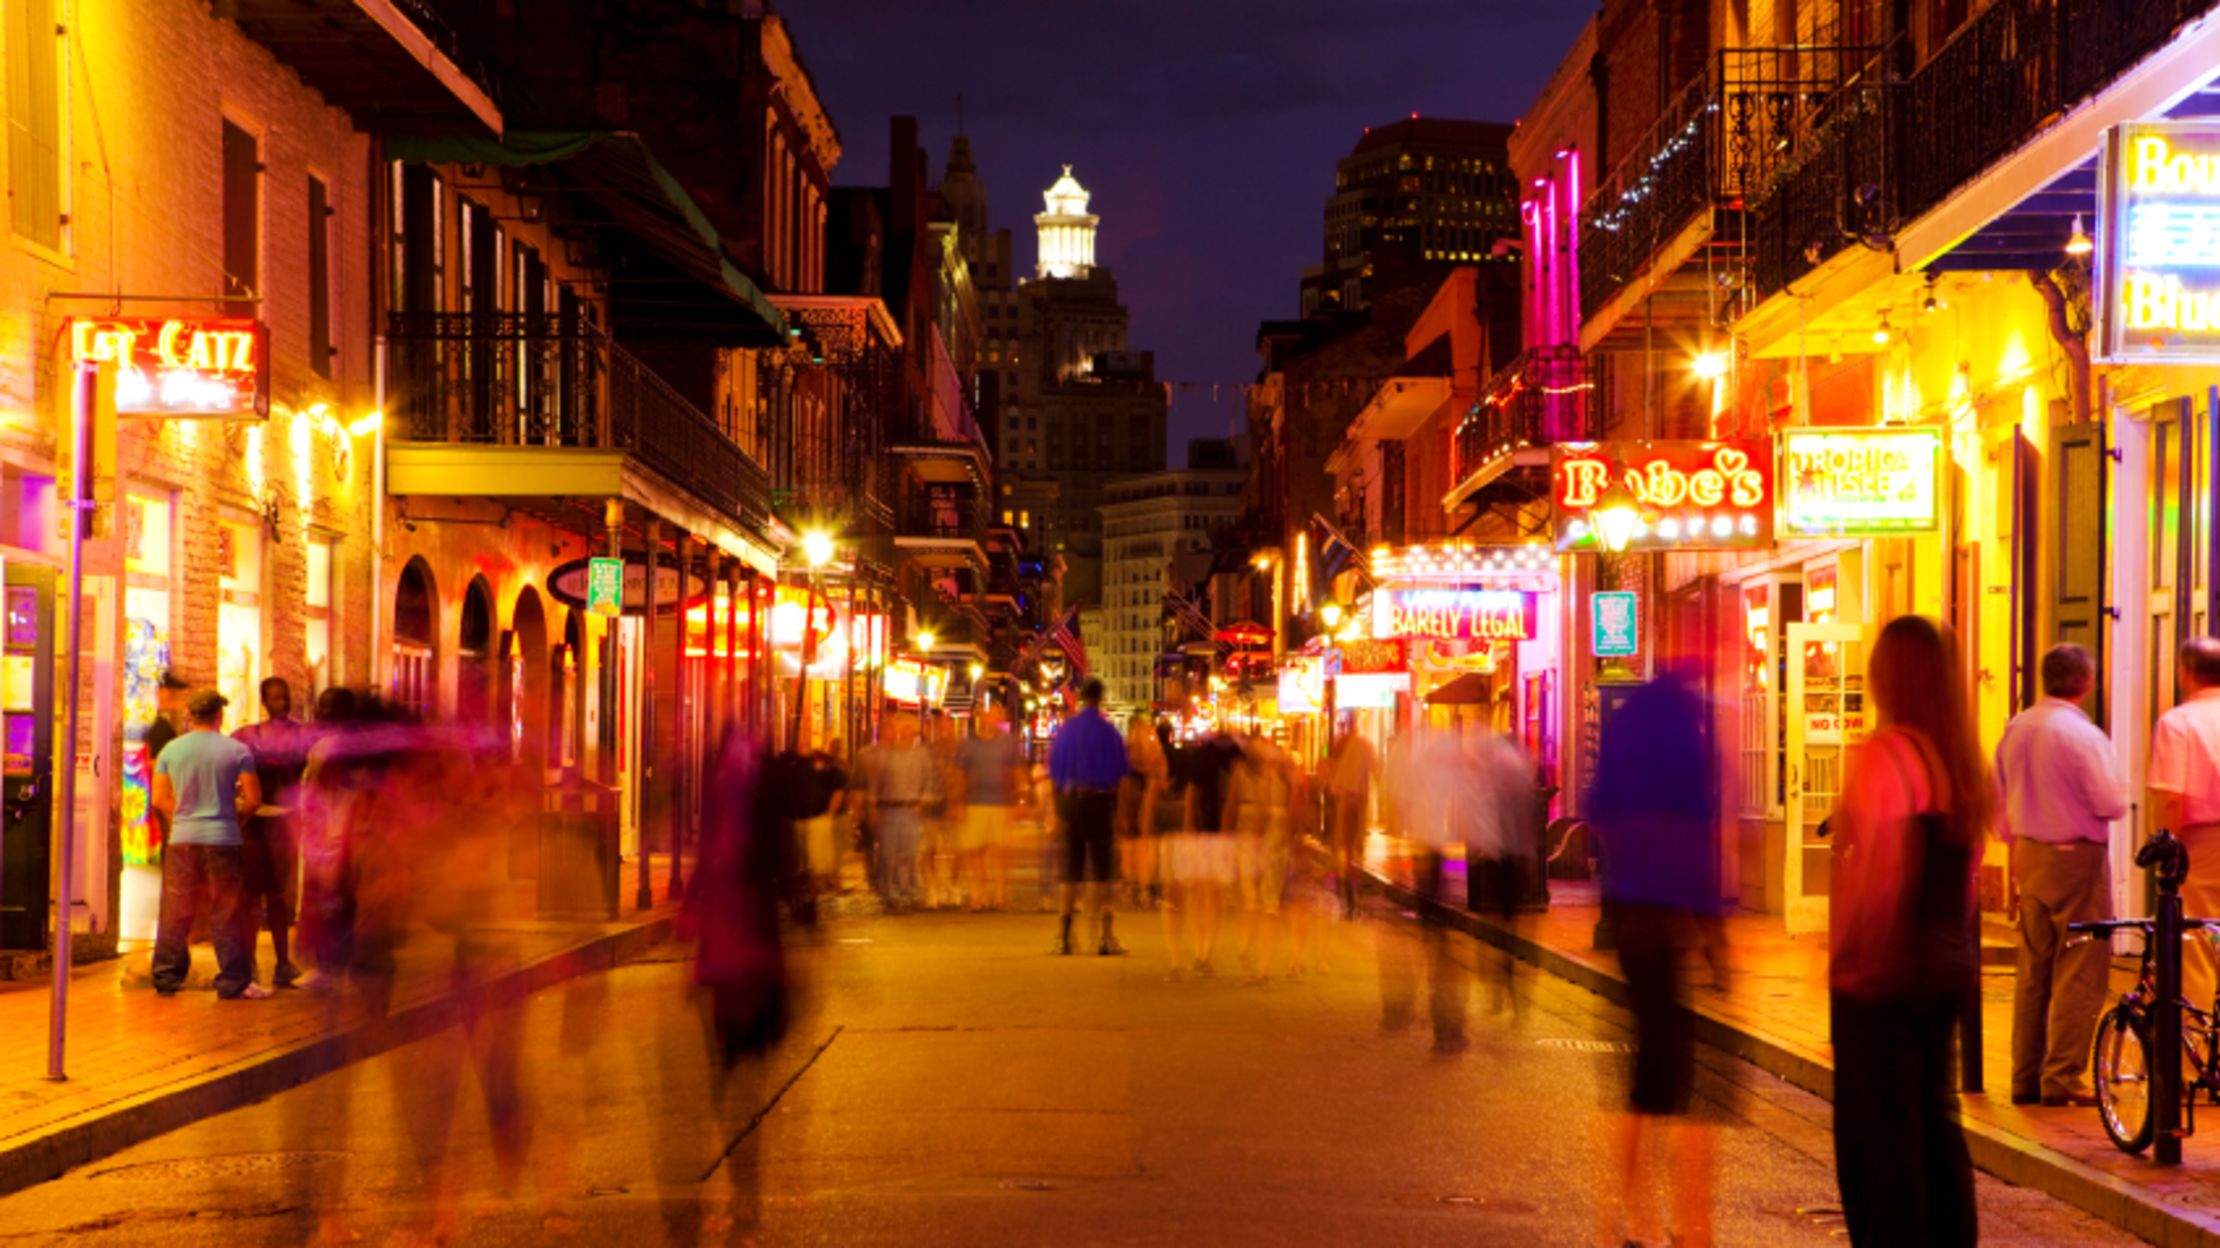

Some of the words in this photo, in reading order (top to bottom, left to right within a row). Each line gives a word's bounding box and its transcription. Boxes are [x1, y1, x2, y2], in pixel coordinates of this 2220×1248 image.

[1391, 605, 1461, 638] BARELY
[1471, 606, 1527, 640] LEGAL
[1810, 718, 1830, 731] NO
